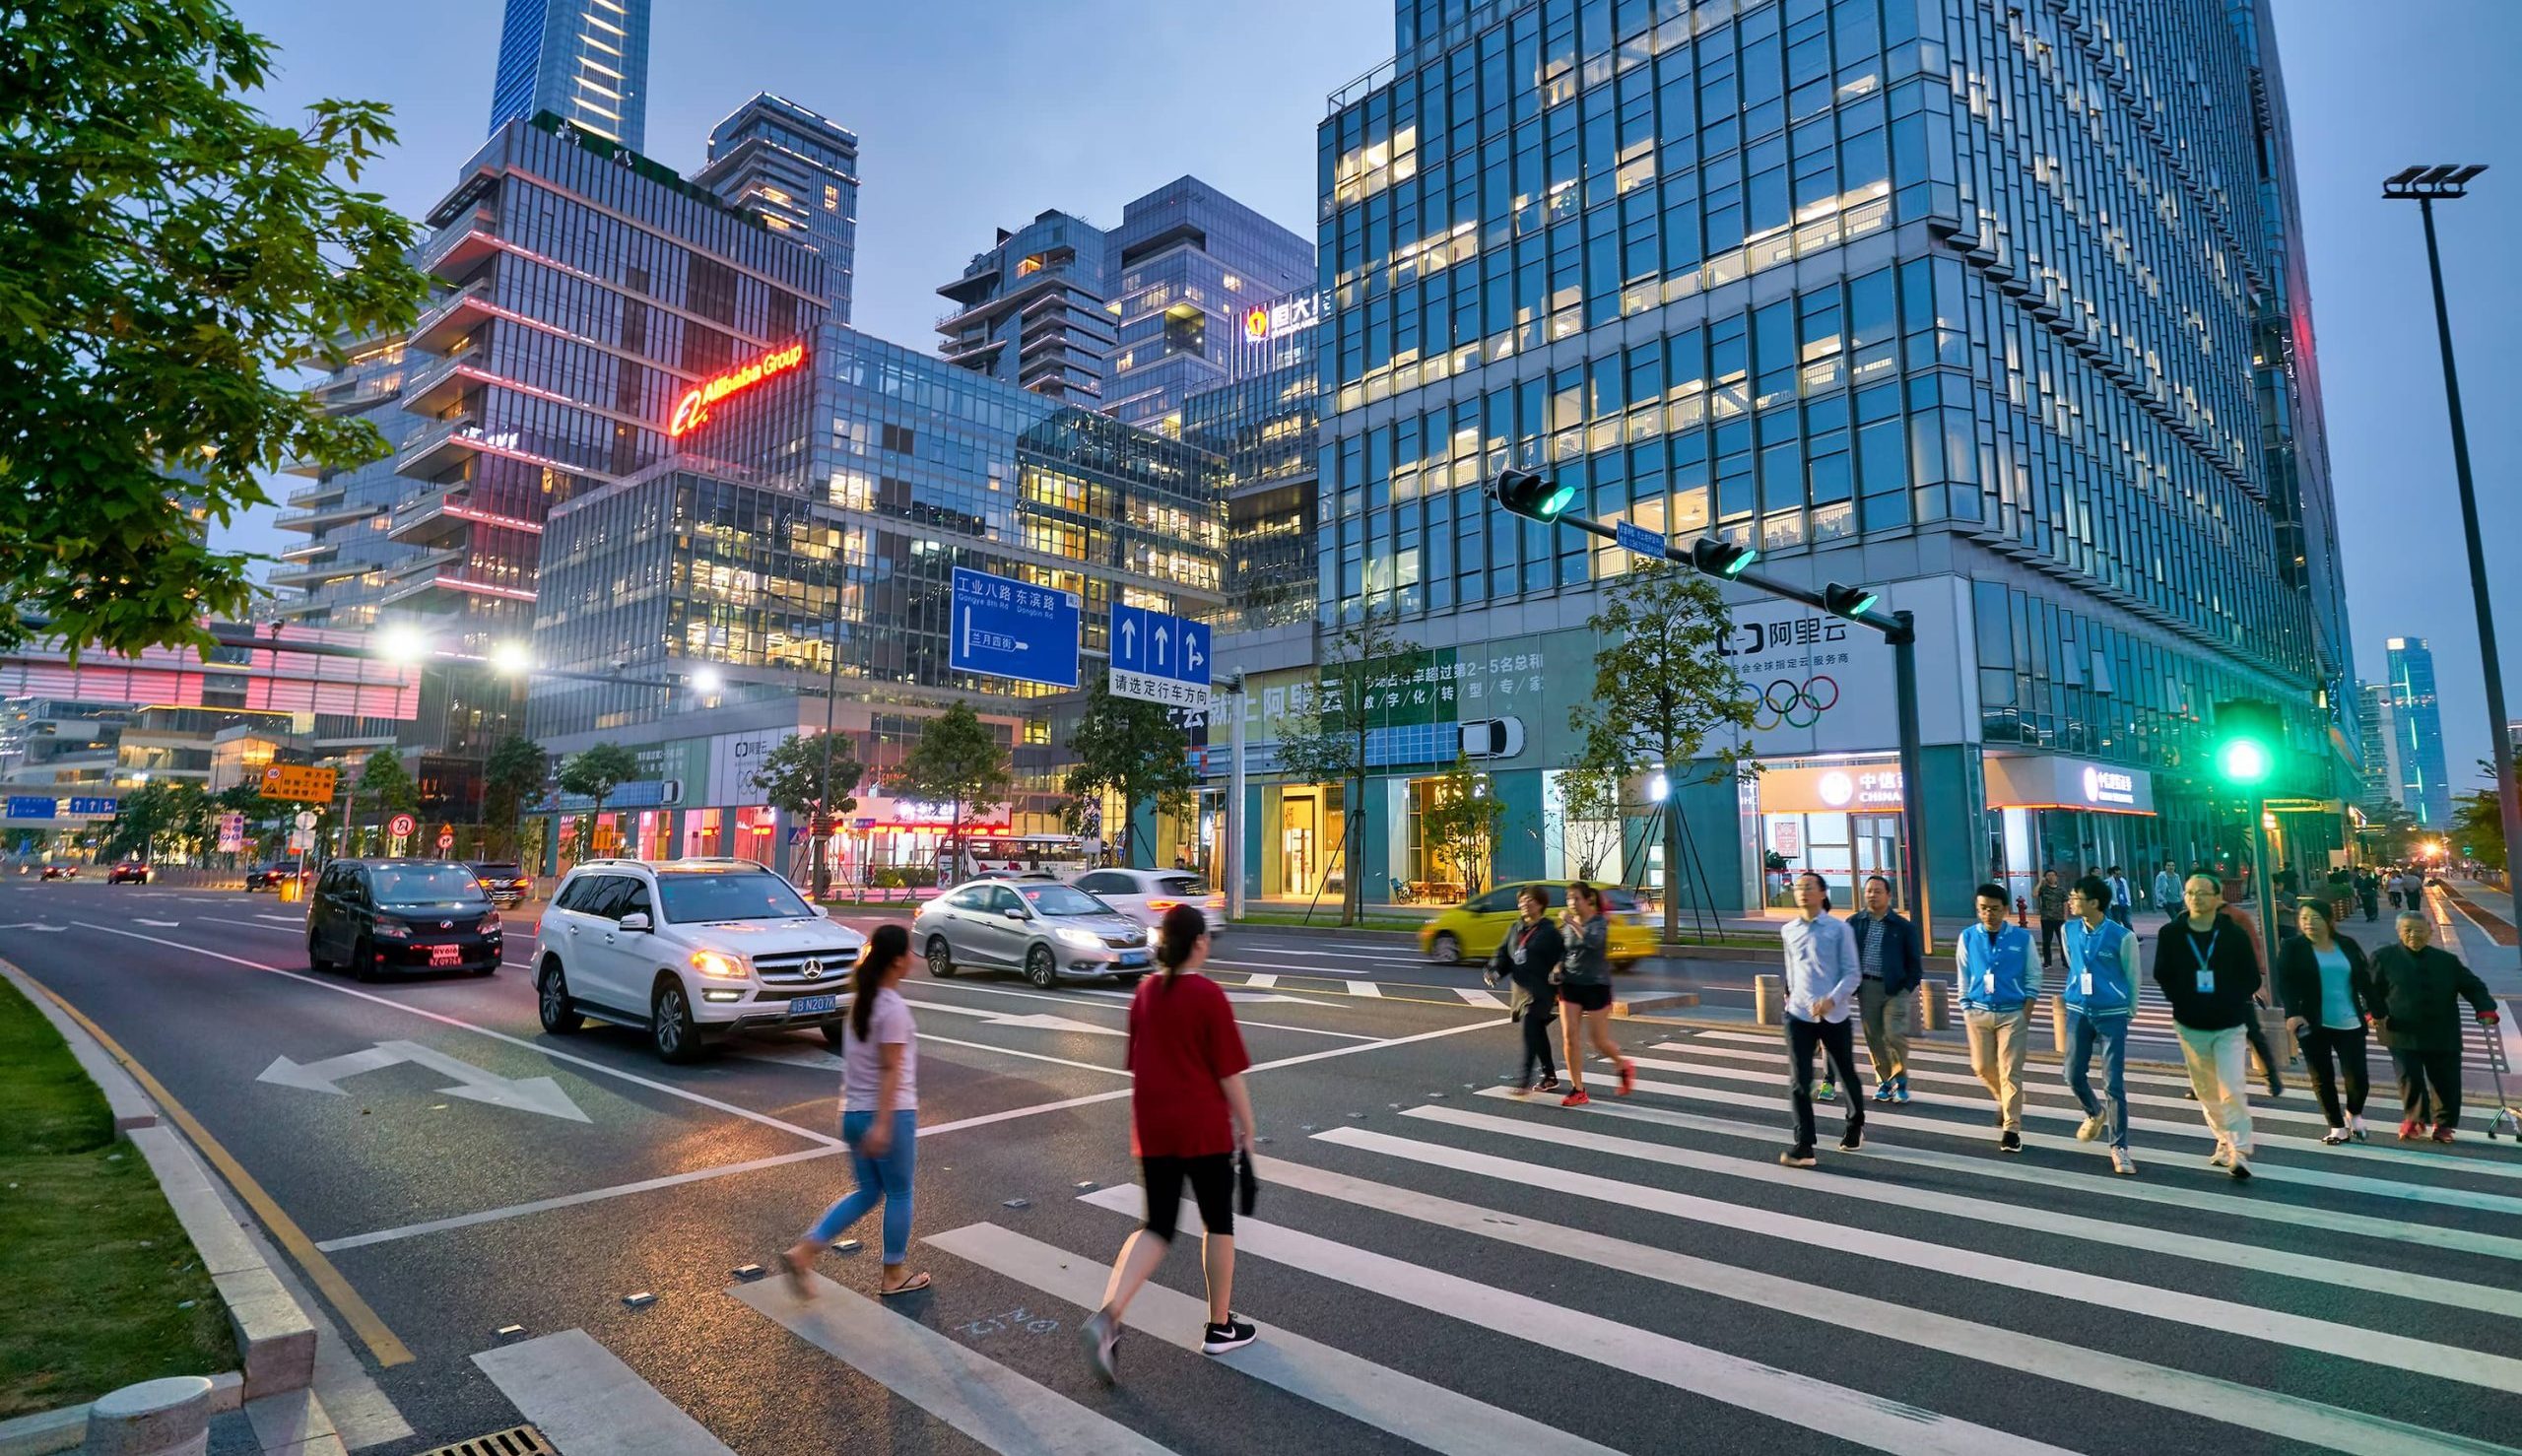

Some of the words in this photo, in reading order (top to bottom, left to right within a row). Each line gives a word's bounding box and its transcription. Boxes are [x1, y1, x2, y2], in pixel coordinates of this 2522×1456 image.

[701, 364, 763, 405] Alibaba
[763, 345, 803, 376] Group
[957, 576, 1011, 602] 工业八路
[1016, 588, 1055, 611] 东滨路
[958, 593, 984, 606] Gongye
[999, 601, 1010, 610] Rd
[1017, 606, 1043, 618] Dongbin
[971, 631, 1013, 650] 兰月四街
[1769, 616, 1846, 648] 阿里云
[1114, 674, 1208, 706] 请选定行车方向
[1859, 792, 1901, 803] CHINA
